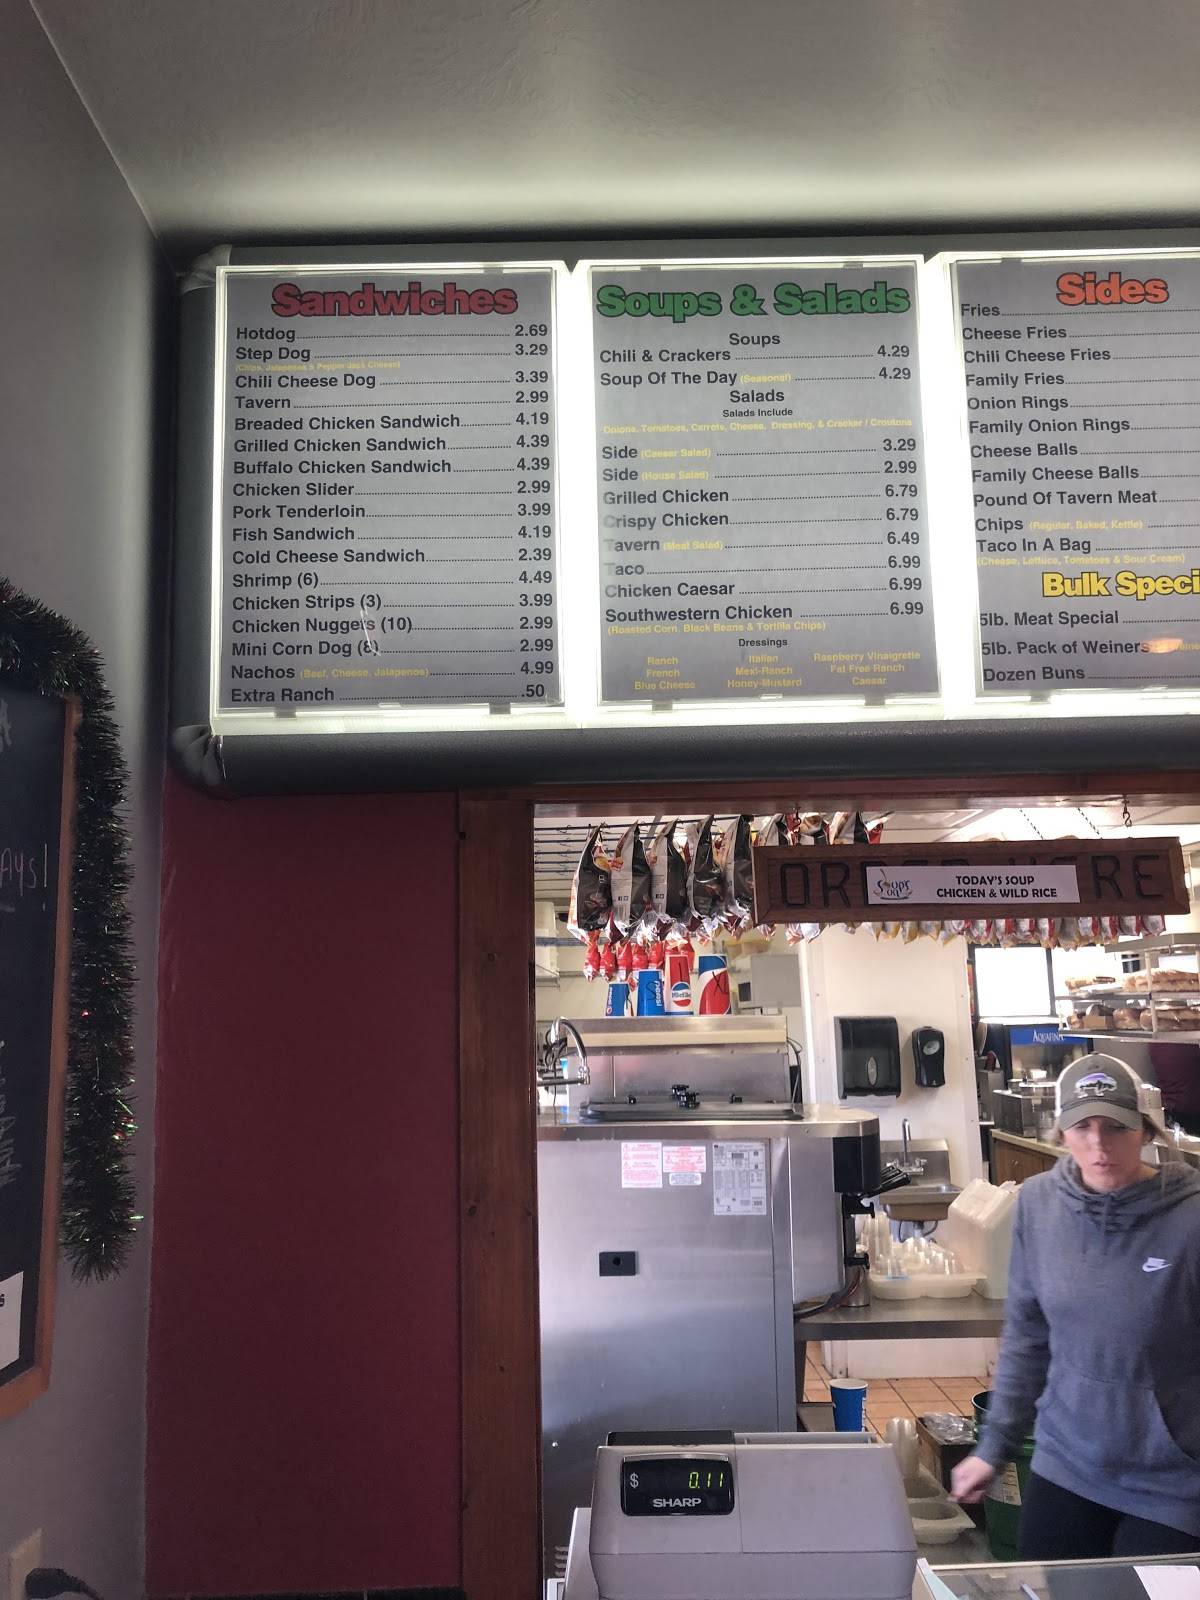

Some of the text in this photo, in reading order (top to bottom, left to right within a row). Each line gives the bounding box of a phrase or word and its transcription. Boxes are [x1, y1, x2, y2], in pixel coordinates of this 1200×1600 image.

[1056, 271, 1169, 306] Sides
[271, 282, 518, 317] Sandwiches
[596, 281, 910, 323] Soups & Salads
[961, 304, 1000, 317] Fries
[236, 325, 547, 342] Hotdog 2.69
[729, 333, 780, 347] Soups
[962, 327, 1067, 340] Cheese Fries
[236, 344, 548, 362] Step Dog 3.29
[600, 346, 910, 363] Chili & Crackers 4.29
[964, 349, 1111, 363] Chili Cheese Fries
[235, 371, 548, 389] Chili Cheese Dog 3.39
[600, 368, 911, 388] Soup Of The Day (Seasonal) 4.29
[966, 373, 1064, 388] Family Fries
[235, 391, 549, 410] Tavern 2.99
[730, 389, 784, 403] Salads
[967, 396, 1069, 411] Onion Rings
[235, 413, 549, 430] Breaded Chicken Sandwich 4.19
[723, 408, 793, 418] Salads Include
[969, 418, 1130, 435] Family Onion Rings
[234, 435, 550, 452] Grilled Chicken Sandwich 4.39
[602, 439, 916, 459] Side 3.29
[970, 443, 1078, 457] Cheese Balls
[234, 458, 550, 474] Buffalo Chicken Sandwich 4.39
[602, 461, 917, 481] Side 2.99
[972, 466, 1139, 484] Family Cheese Balls
[233, 481, 550, 496] Chicken Slider 2.99
[603, 484, 918, 505] Grilled Chicken 6.79
[974, 490, 1157, 507] Pound Of Tavern Meat
[232, 504, 551, 518] Pork Tenderloin 3.99
[603, 508, 918, 530] Crispy Chicken 6.79
[232, 526, 551, 541] Fish Sandwich 4.19
[975, 518, 1024, 534] Chips
[887, 532, 920, 545] 6.49
[977, 538, 1090, 554] Taco In A Bag
[232, 549, 552, 564] Cold Cheese Sandwich 2.39
[888, 556, 921, 568] 6.99
[232, 571, 552, 590] Shrimp (6) 4.49
[605, 578, 922, 598] Chicken Caesar 6.99
[1042, 571, 1112, 597] Bulk
[232, 594, 552, 612] Chicken Strips (3) 3.99
[605, 602, 924, 622] Southwestern Chicken 6.99
[980, 611, 1119, 628] 5lb. Meat Special
[232, 617, 553, 634] Chicken Nuggets (10) 2.99
[232, 643, 267, 657] Mini
[273, 642, 313, 655] Corn
[319, 641, 352, 657] Dog
[520, 639, 553, 652] 2.99
[738, 638, 788, 648] Dressings
[982, 642, 1012, 655] 5lb.
[1017, 641, 1057, 654] Pack
[1062, 641, 1078, 654] of
[1082, 640, 1150, 653] Weiners
[232, 662, 554, 679] Nachos 4.99
[984, 666, 1085, 682] Dozen Buns
[232, 686, 545, 702] Extra Ranch .50
[956, 875, 1034, 885] TODAY'S SOUP
[937, 887, 1057, 898] CHICKEN & WILD RICE
[630, 1472, 723, 1488] $ 0.11
[653, 1498, 701, 1507] SHARP
